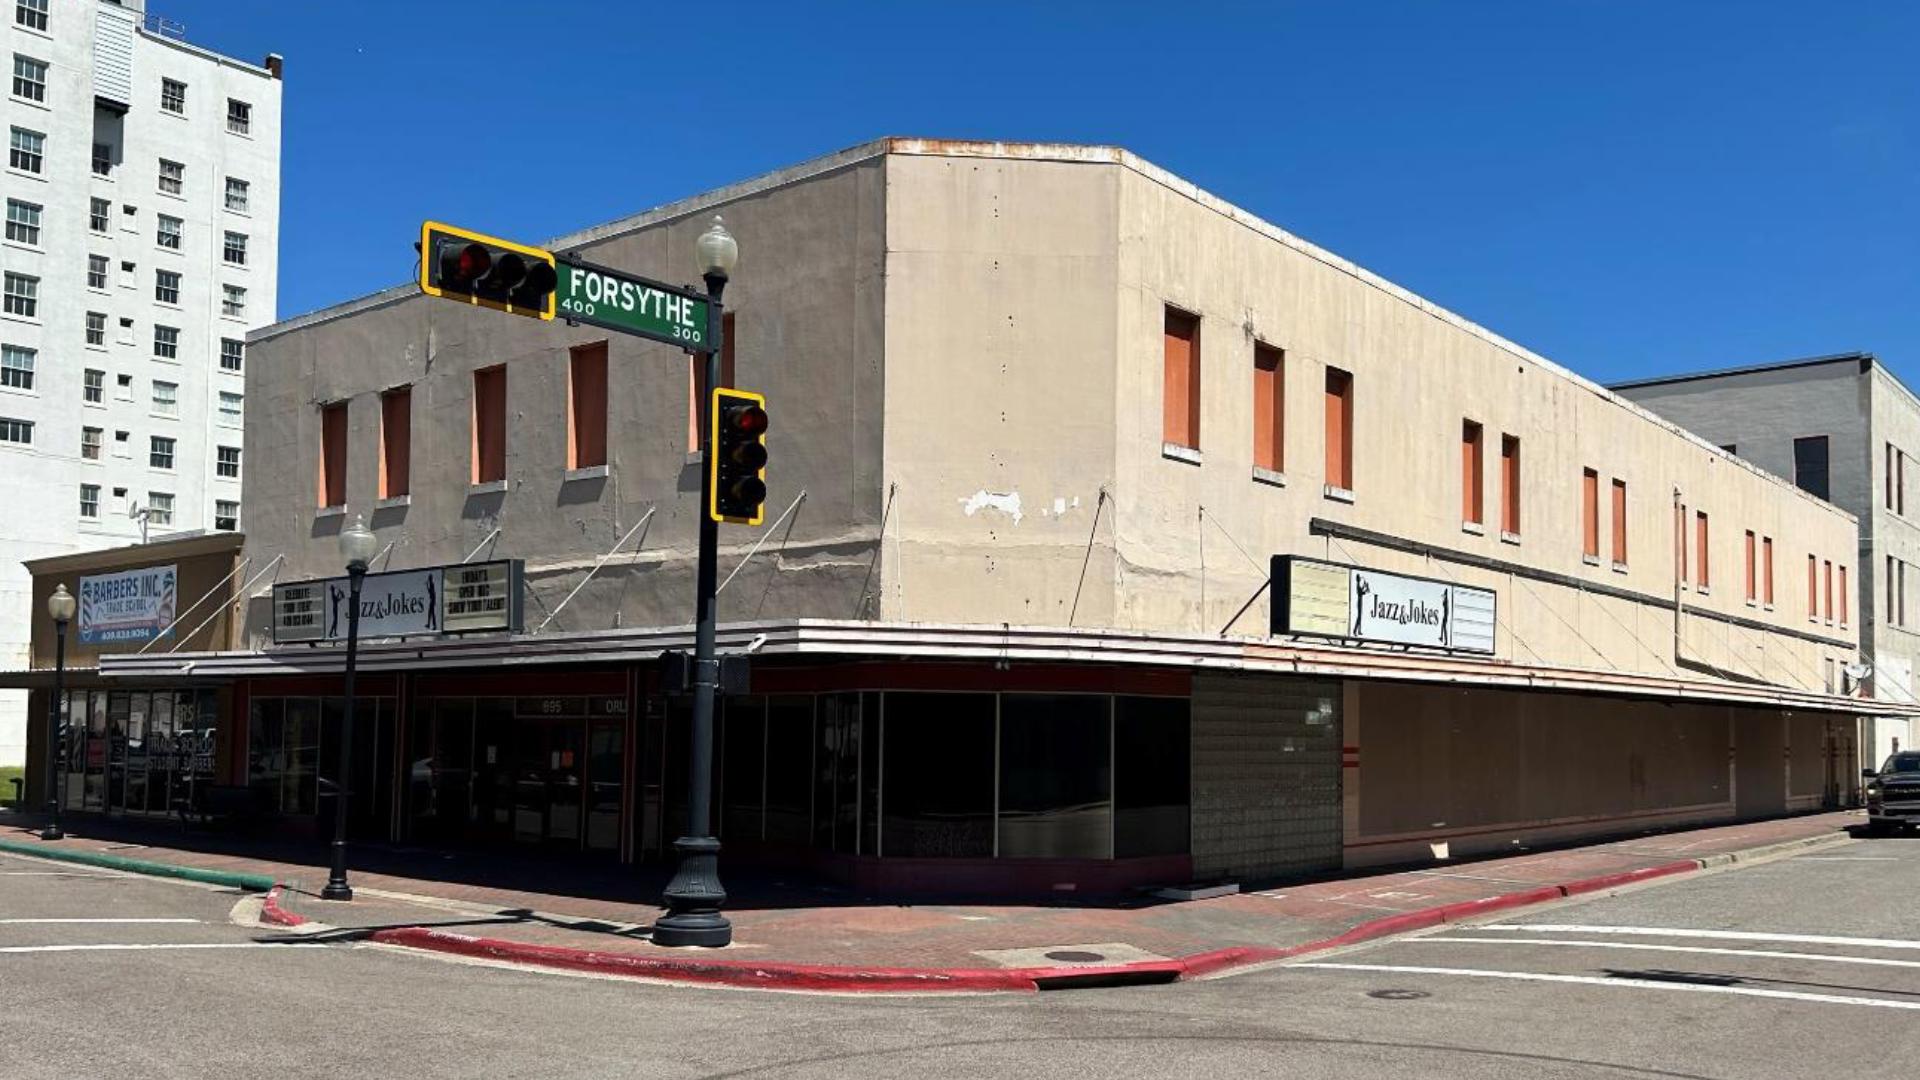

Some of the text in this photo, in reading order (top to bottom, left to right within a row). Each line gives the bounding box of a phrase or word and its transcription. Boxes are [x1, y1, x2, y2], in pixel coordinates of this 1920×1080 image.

[561, 298, 595, 316] 400
[570, 269, 695, 327] FORSYTHE
[672, 325, 701, 343] 300
[93, 574, 161, 605] BARBERS INC.
[345, 592, 425, 620] zz&Jokes
[1370, 594, 1440, 626] Jazz&Jokes
